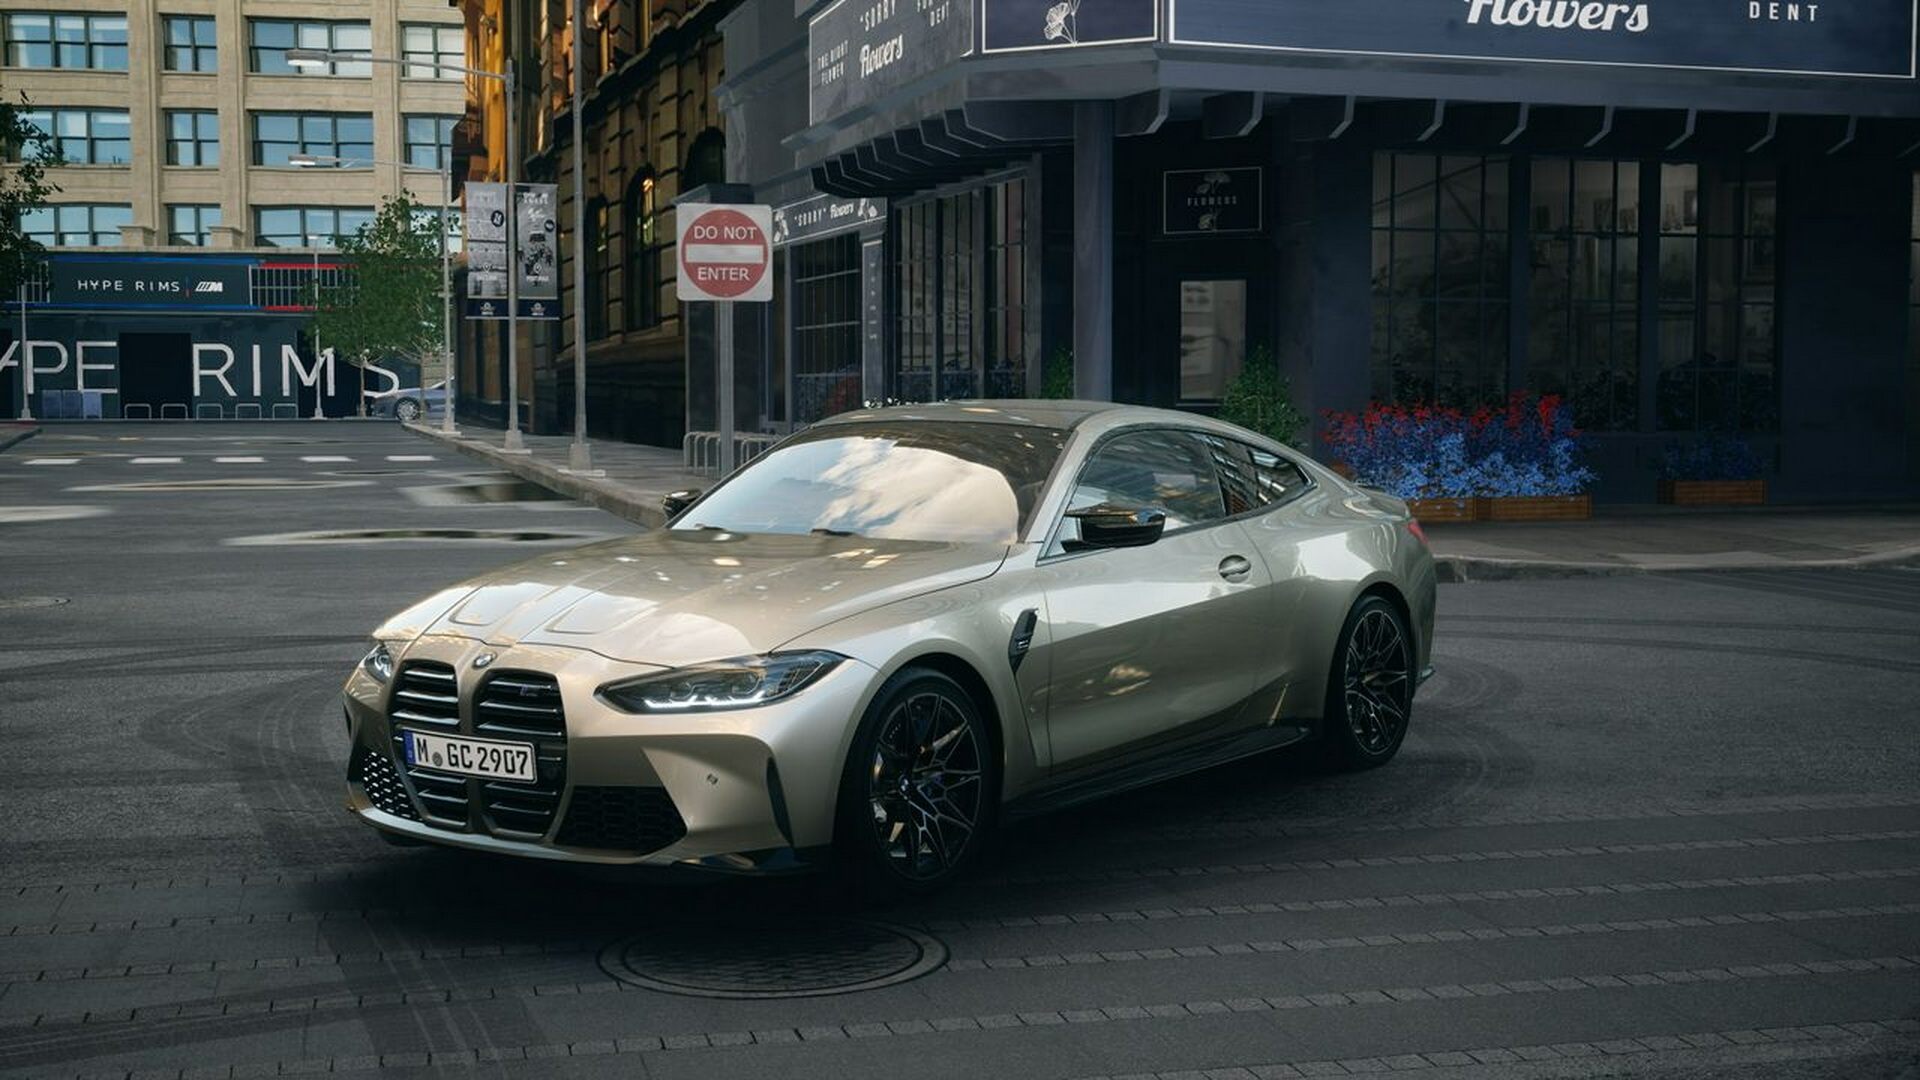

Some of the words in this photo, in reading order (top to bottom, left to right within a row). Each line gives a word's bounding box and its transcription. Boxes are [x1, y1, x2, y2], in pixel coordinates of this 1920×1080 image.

[1749, 1, 1818, 21] DENT
[693, 226, 718, 240] DO
[723, 226, 757, 240] NOT
[697, 267, 750, 281] ENTER
[77, 280, 124, 291] HYPE
[135, 280, 181, 292] RIMS
[192, 342, 400, 398] RIMS
[416, 737, 429, 763] M
[446, 743, 474, 769] GC
[477, 746, 529, 776] 2907
